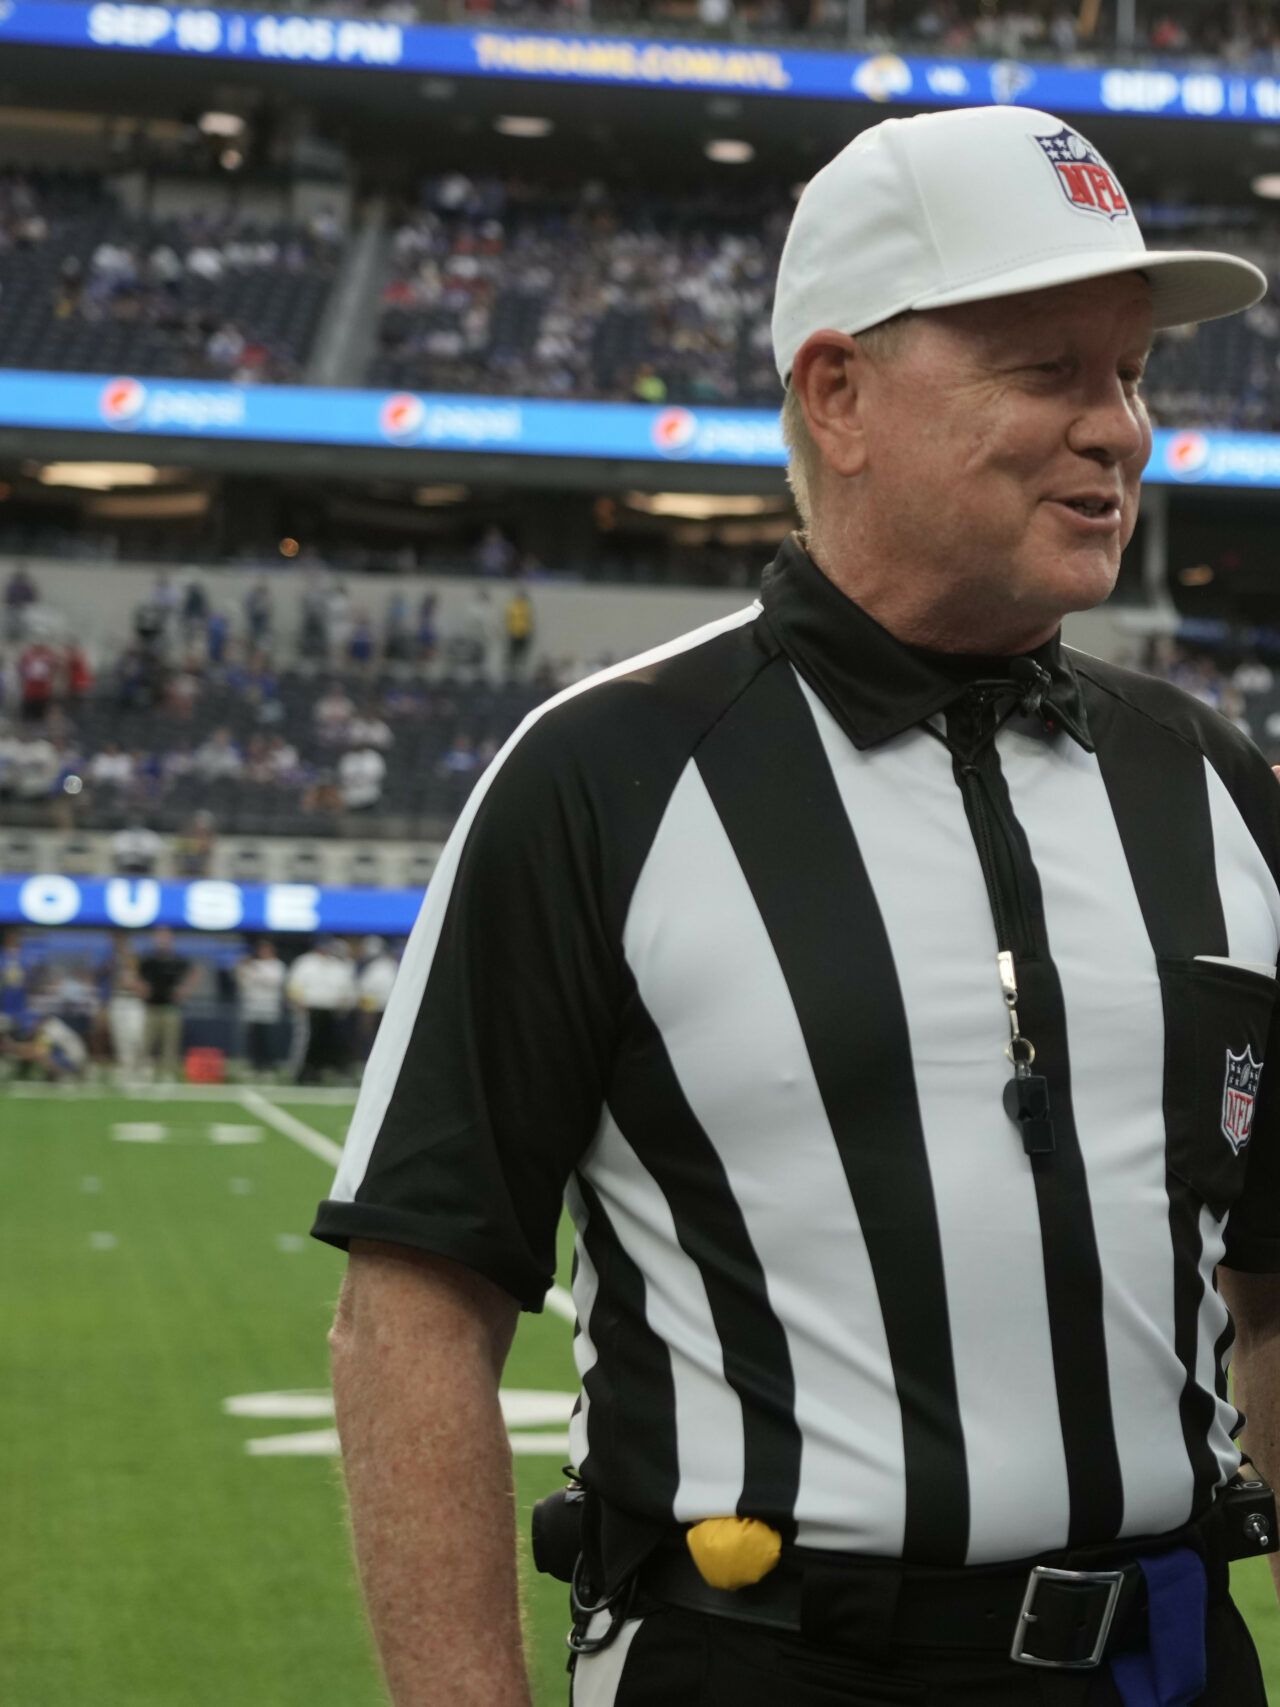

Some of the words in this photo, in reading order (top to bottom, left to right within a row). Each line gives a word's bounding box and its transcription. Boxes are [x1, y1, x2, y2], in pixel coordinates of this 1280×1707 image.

[88, 2, 172, 47] SEP
[336, 20, 402, 65] PM
[1101, 68, 1179, 112] SEP
[1056, 163, 1127, 213] NFL
[426, 403, 522, 446] pepsi
[697, 418, 783, 459] peps
[1227, 1090, 1254, 1137] NFL
